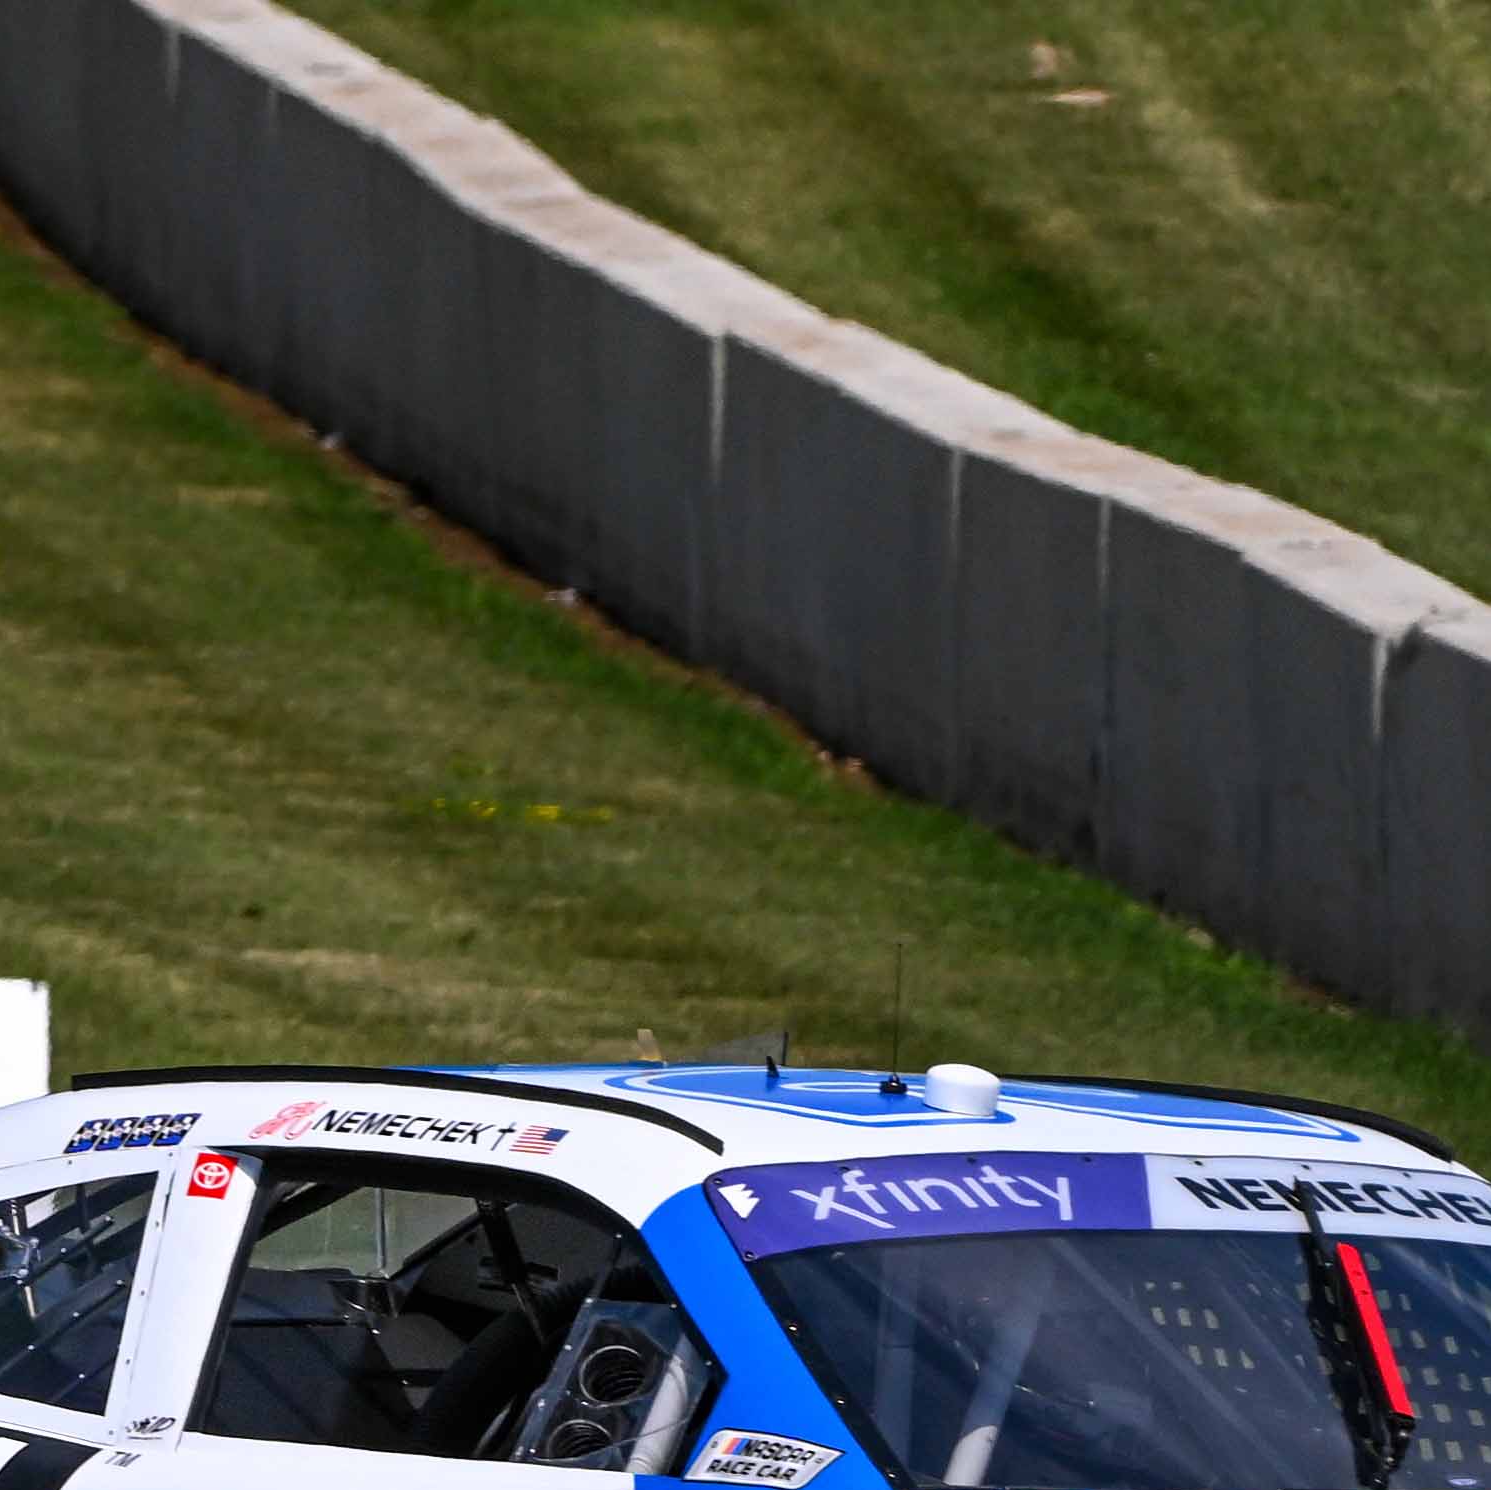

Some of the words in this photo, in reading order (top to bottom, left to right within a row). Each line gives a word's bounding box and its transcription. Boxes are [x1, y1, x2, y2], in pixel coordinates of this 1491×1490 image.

[312, 1109, 495, 1145] NEMECHEK
[790, 1164, 1073, 1229] xfinity
[741, 1438, 816, 1465] NASCAR
[708, 1459, 756, 1477] RACE
[757, 1464, 798, 1482] CAR
